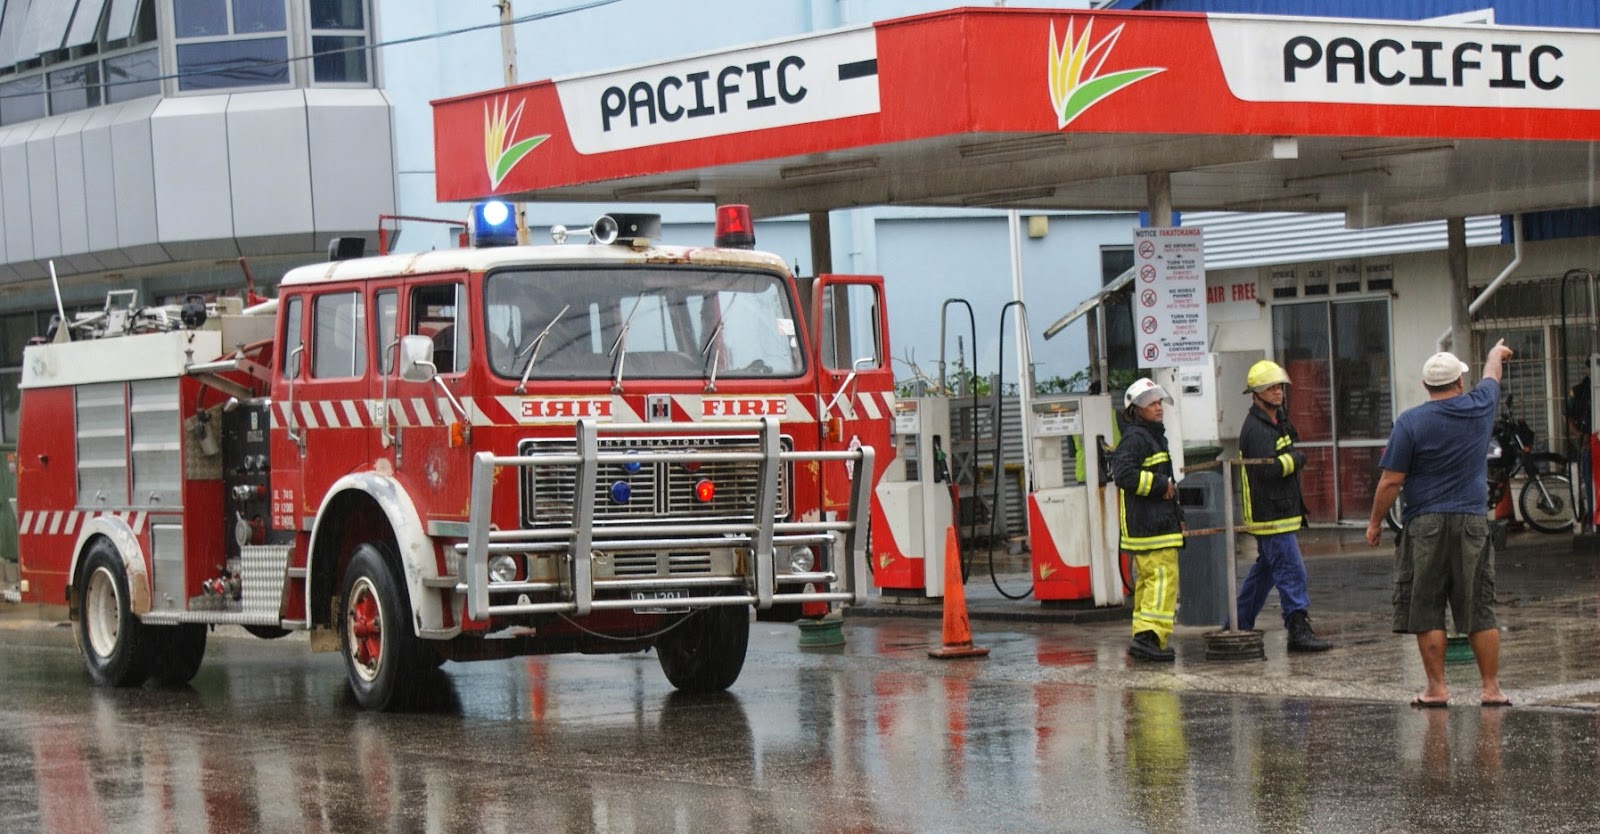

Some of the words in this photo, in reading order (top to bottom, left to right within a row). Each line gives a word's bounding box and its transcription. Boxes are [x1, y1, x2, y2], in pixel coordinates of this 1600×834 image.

[1283, 35, 1564, 91] PACIFIC
[600, 55, 808, 132] PACIFIC
[1159, 229, 1200, 237] FAKATOKANGA
[1206, 286, 1225, 304] AIR
[1231, 283, 1256, 301] FREE
[702, 400, 787, 416] FIRE
[598, 439, 719, 447] INTERNATIONAL
